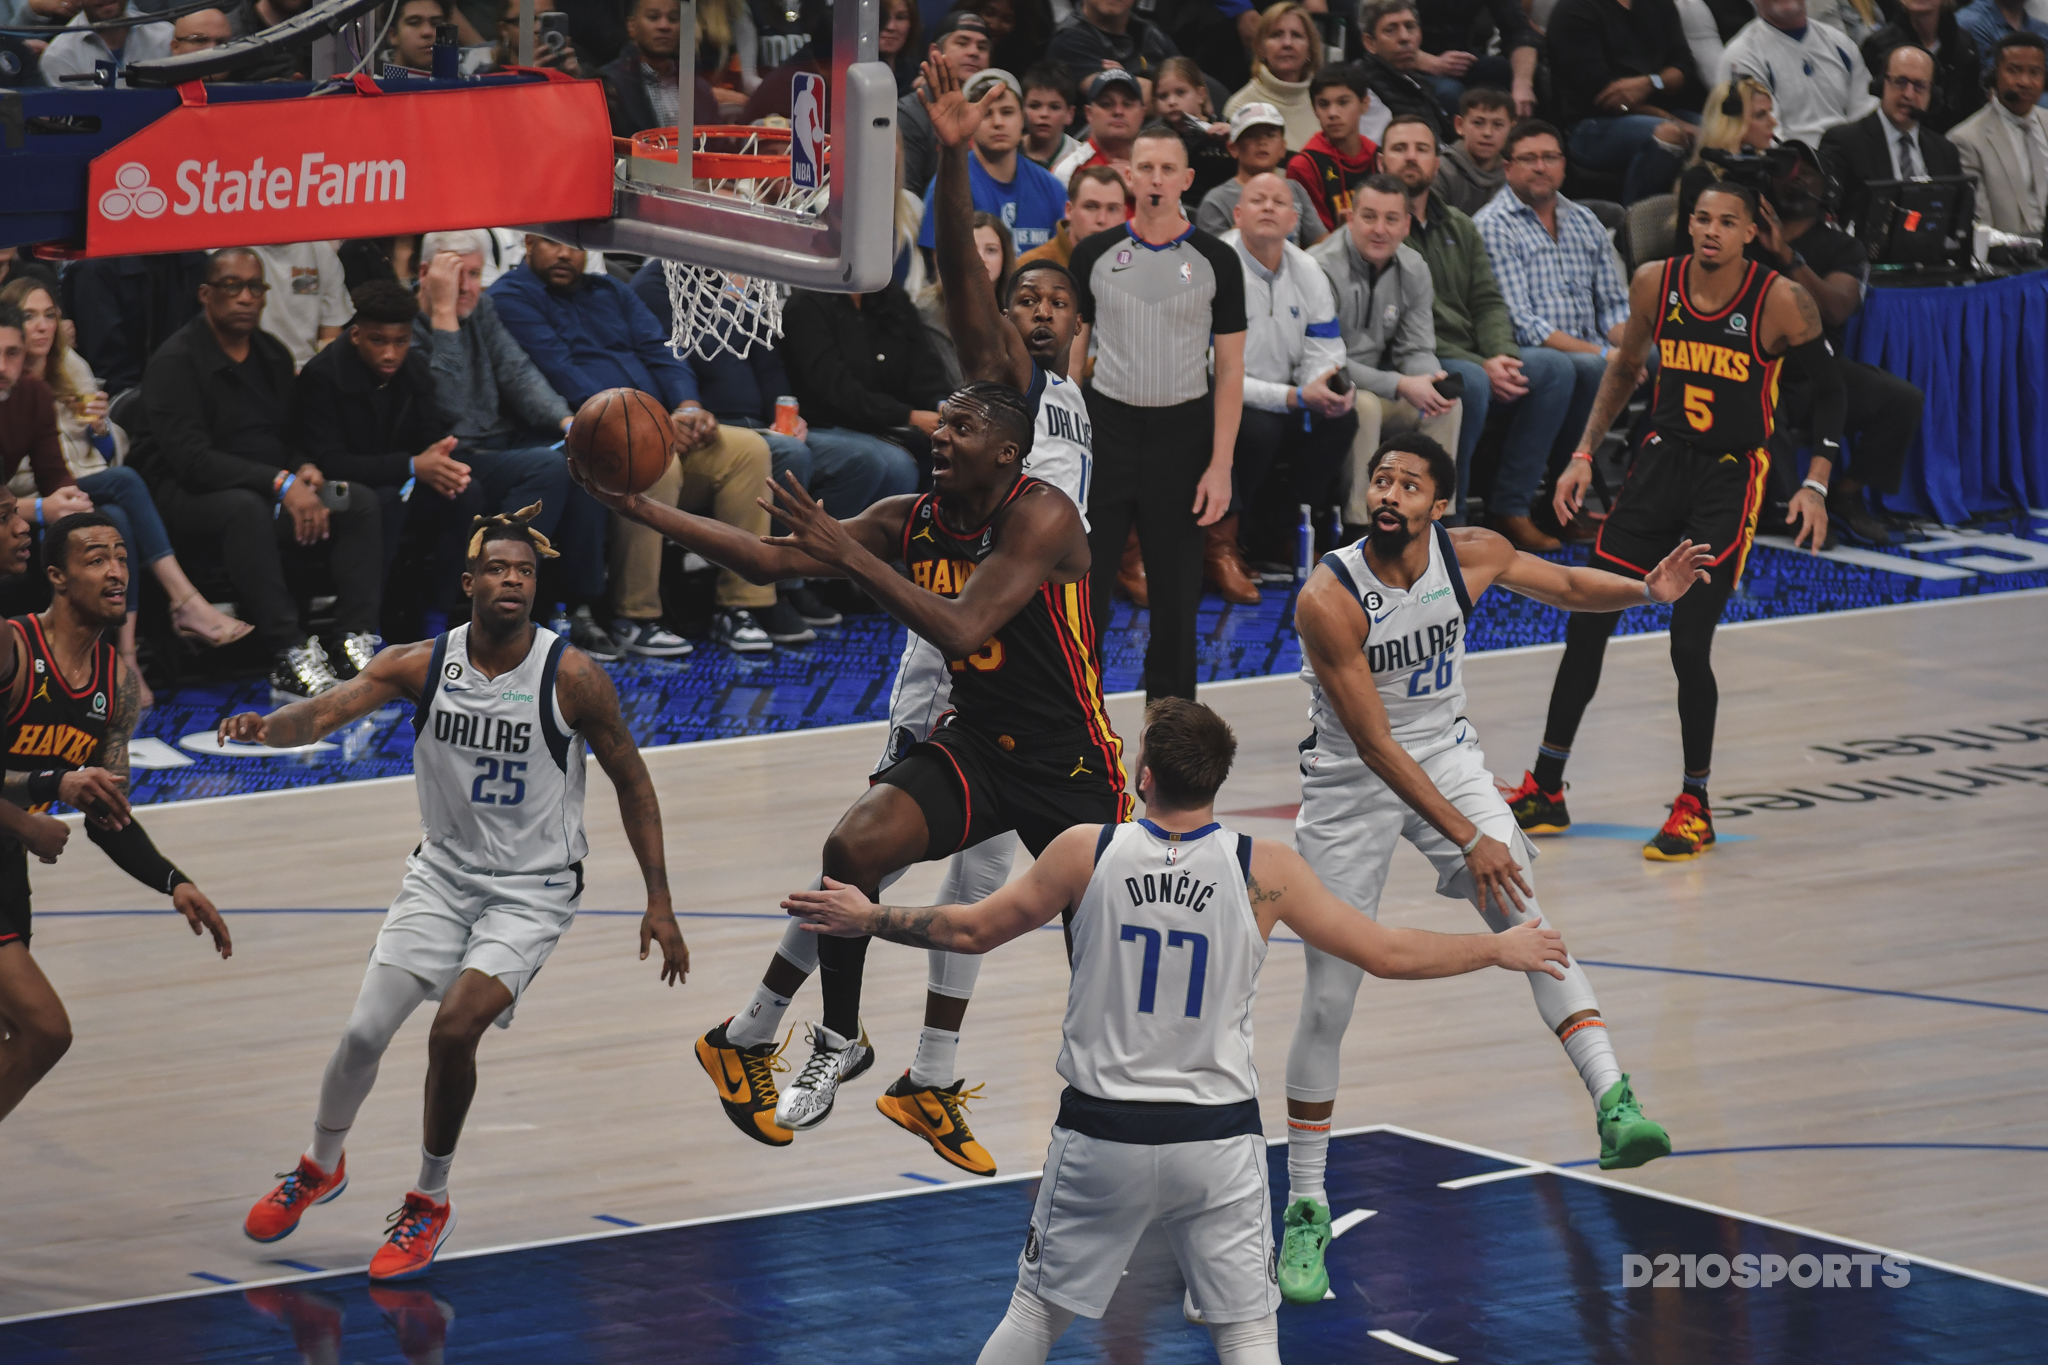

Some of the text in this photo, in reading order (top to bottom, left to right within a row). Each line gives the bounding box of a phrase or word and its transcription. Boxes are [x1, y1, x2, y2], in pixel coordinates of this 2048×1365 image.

[795, 161, 811, 182] NBA
[1669, 291, 1679, 305] 6
[1660, 338, 1750, 383] HAWKS
[1684, 383, 1715, 432] 5
[921, 504, 931, 519] 6
[911, 558, 978, 594] HAW
[1367, 593, 1380, 610] 6
[1421, 586, 1452, 605] chime
[1368, 616, 1459, 674] DALLAS
[35, 658, 46, 674] 6
[447, 663, 460, 679] 6
[1407, 646, 1454, 697] 26
[502, 690, 534, 703] chime
[435, 709, 532, 754] DALLAS
[471, 756, 528, 806] 25
[1125, 869, 1218, 913] DONČIĆ
[1120, 924, 1209, 1019] 77
